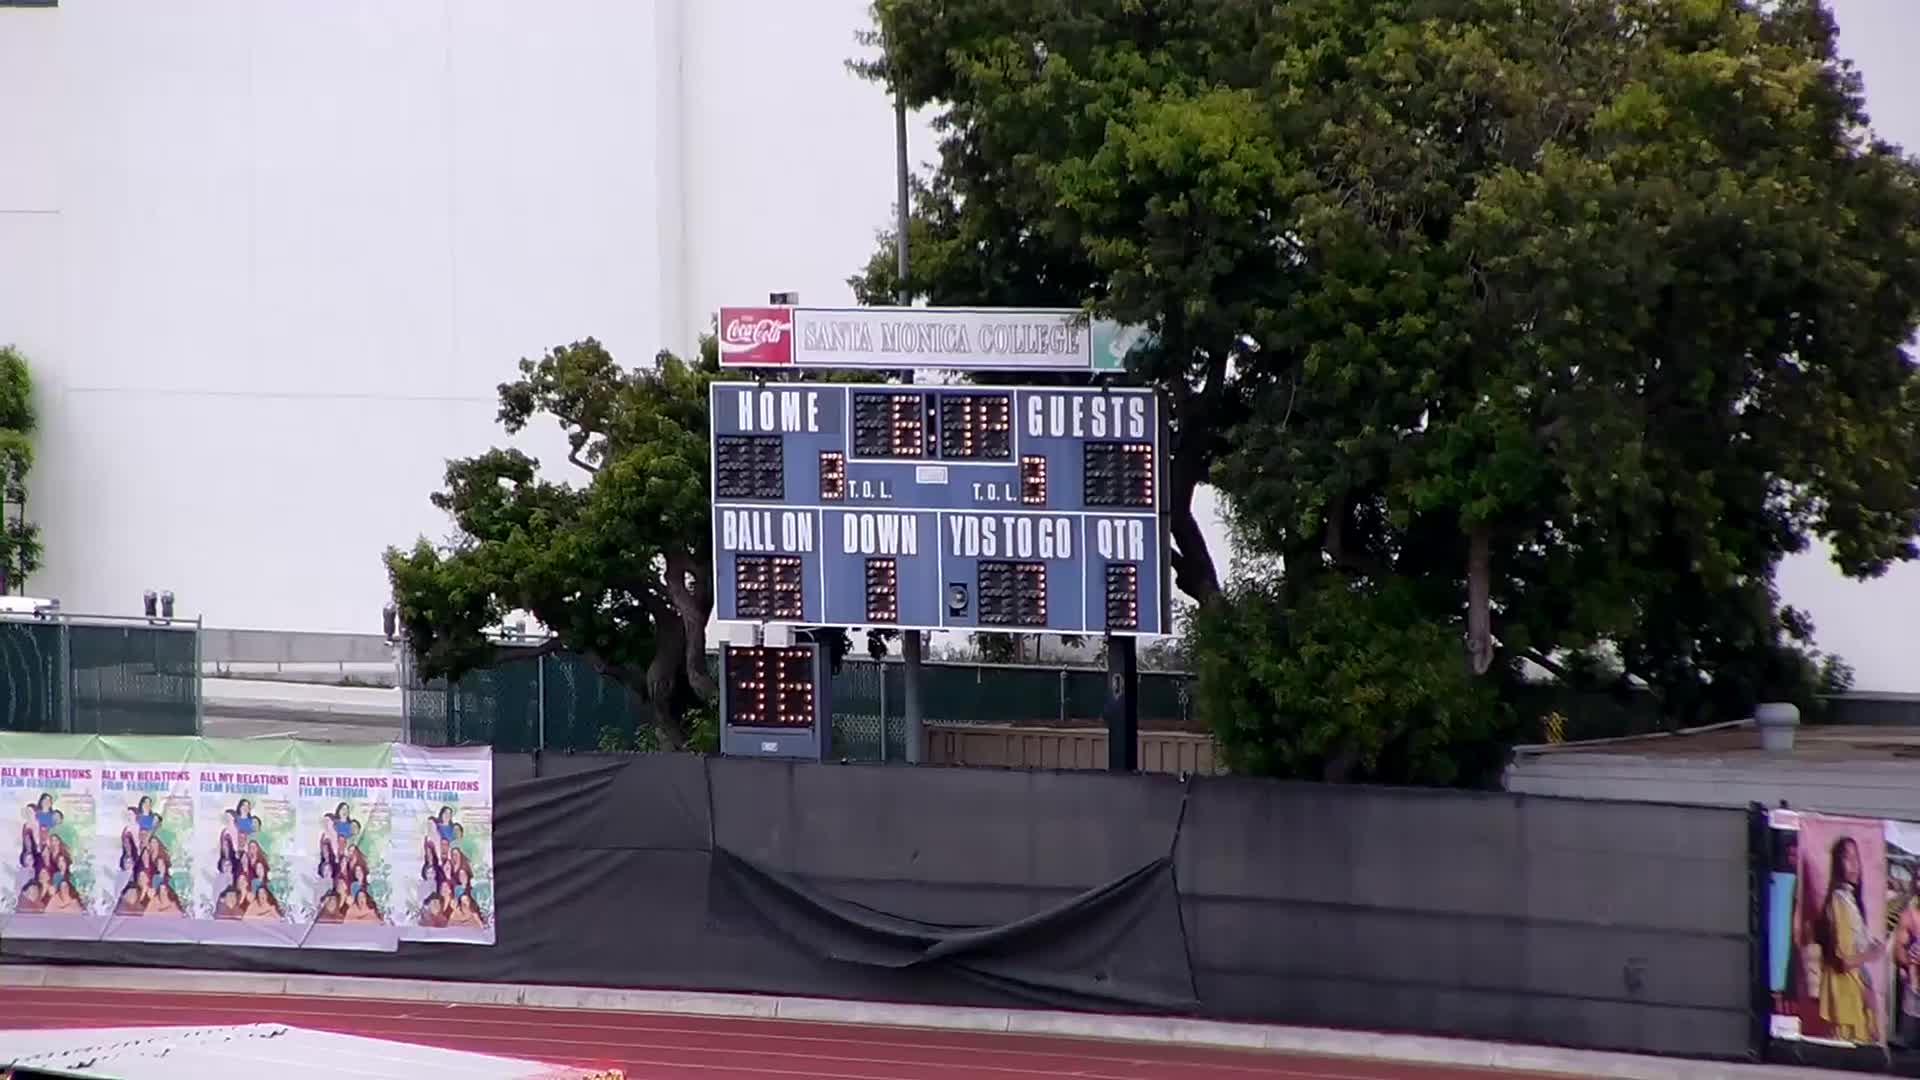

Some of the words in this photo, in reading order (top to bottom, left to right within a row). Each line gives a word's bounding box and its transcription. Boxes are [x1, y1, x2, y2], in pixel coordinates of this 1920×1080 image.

[727, 319, 782, 343] Coca-Cola
[804, 321, 873, 352] SANTA
[880, 322, 972, 353] MONICA
[979, 323, 1080, 355] COLLEGE
[739, 390, 819, 432] HOME
[1028, 395, 1145, 438] GUESTS
[723, 510, 775, 551] BALL
[782, 512, 813, 552] ON
[843, 513, 917, 555] DOWN
[950, 515, 997, 557] YDS
[1003, 516, 1033, 558] TO
[1038, 518, 1071, 559] GO
[1097, 519, 1144, 561] QTR
[1, 767, 17, 777] ALL
[20, 767, 35, 777] MY
[38, 767, 92, 779] RELATIONS
[102, 769, 116, 780] ALL
[120, 770, 135, 780] MY
[138, 771, 190, 781] RELATIONS
[200, 772, 216, 782] ALL
[219, 772, 233, 783] MY
[236, 773, 288, 785] RELATIONS
[299, 776, 316, 787] ALL
[319, 777, 334, 787] MY
[336, 777, 388, 788] RELATIONS
[392, 778, 408, 789] ALL
[411, 779, 425, 790] MY
[427, 780, 479, 791] RELATIONS
